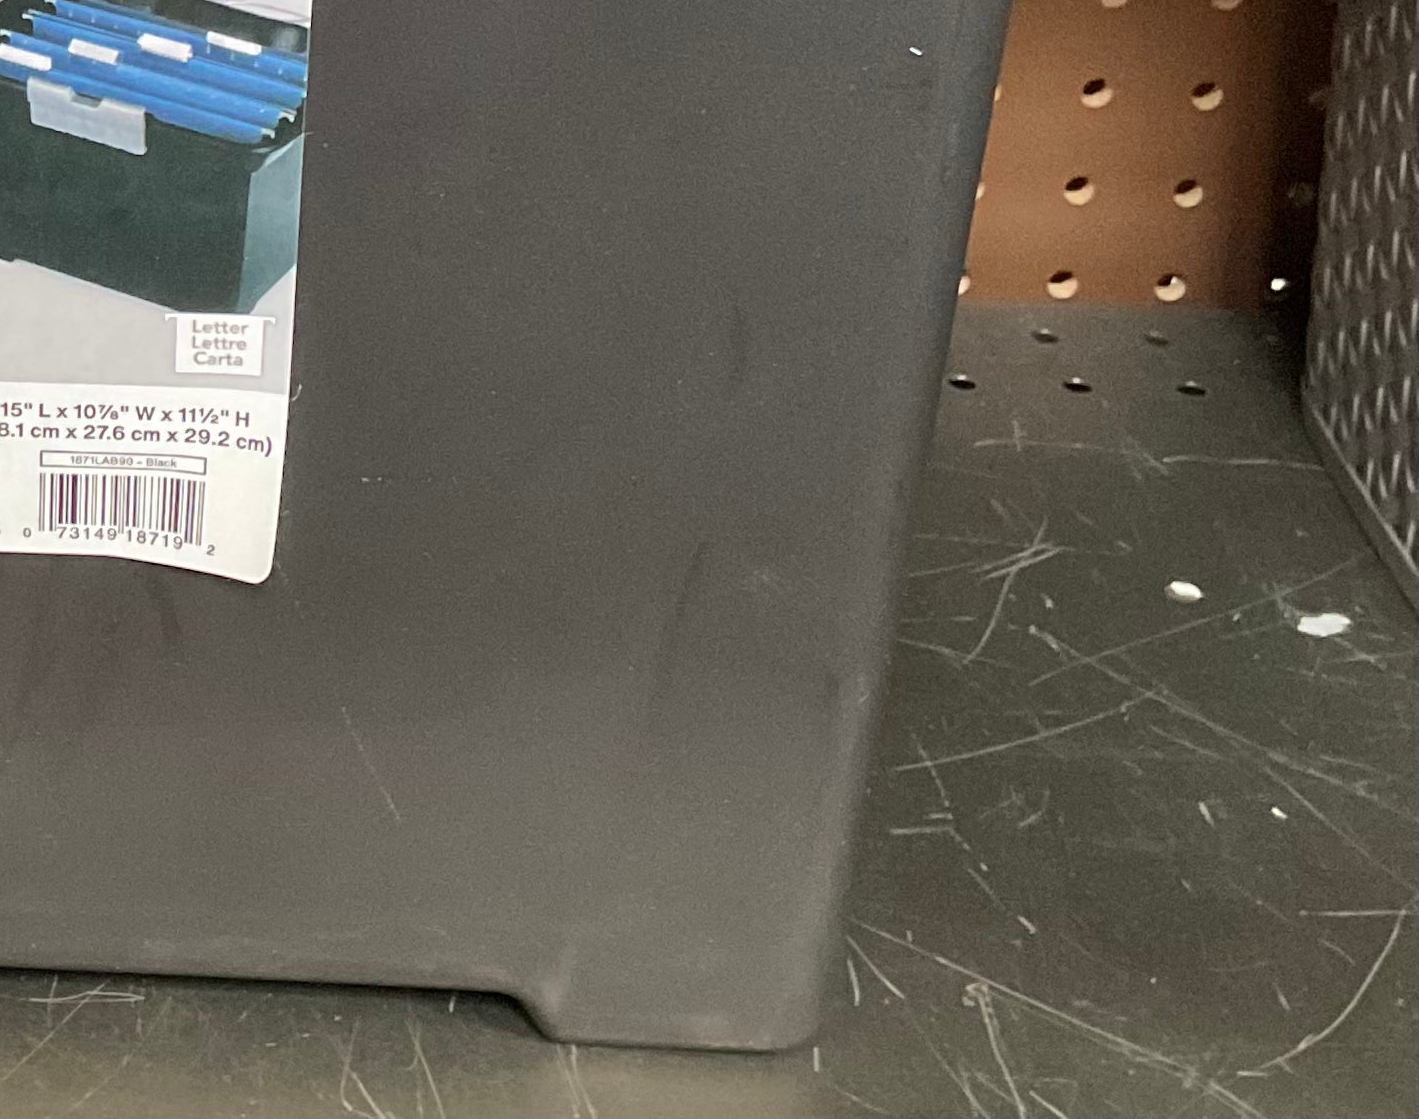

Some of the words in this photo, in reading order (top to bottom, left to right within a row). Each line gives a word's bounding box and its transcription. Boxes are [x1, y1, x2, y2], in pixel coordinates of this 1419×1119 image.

[192, 319, 249, 334] Letter
[192, 335, 247, 351] Lettre
[193, 351, 244, 366] Carta
[39, 403, 51, 419] L
[56, 407, 68, 419] x
[135, 406, 156, 421] W
[161, 410, 173, 422] x
[235, 412, 250, 428] H
[30, 426, 60, 438] cm
[65, 427, 78, 439] x
[83, 425, 126, 441] 27.6
[131, 429, 161, 443] cm
[166, 431, 178, 443] x
[183, 429, 231, 447] 29.2
[236, 436, 273, 458] cm)
[146, 457, 177, 468] Black
[23, 527, 31, 538] 0
[206, 544, 216, 556] 2
